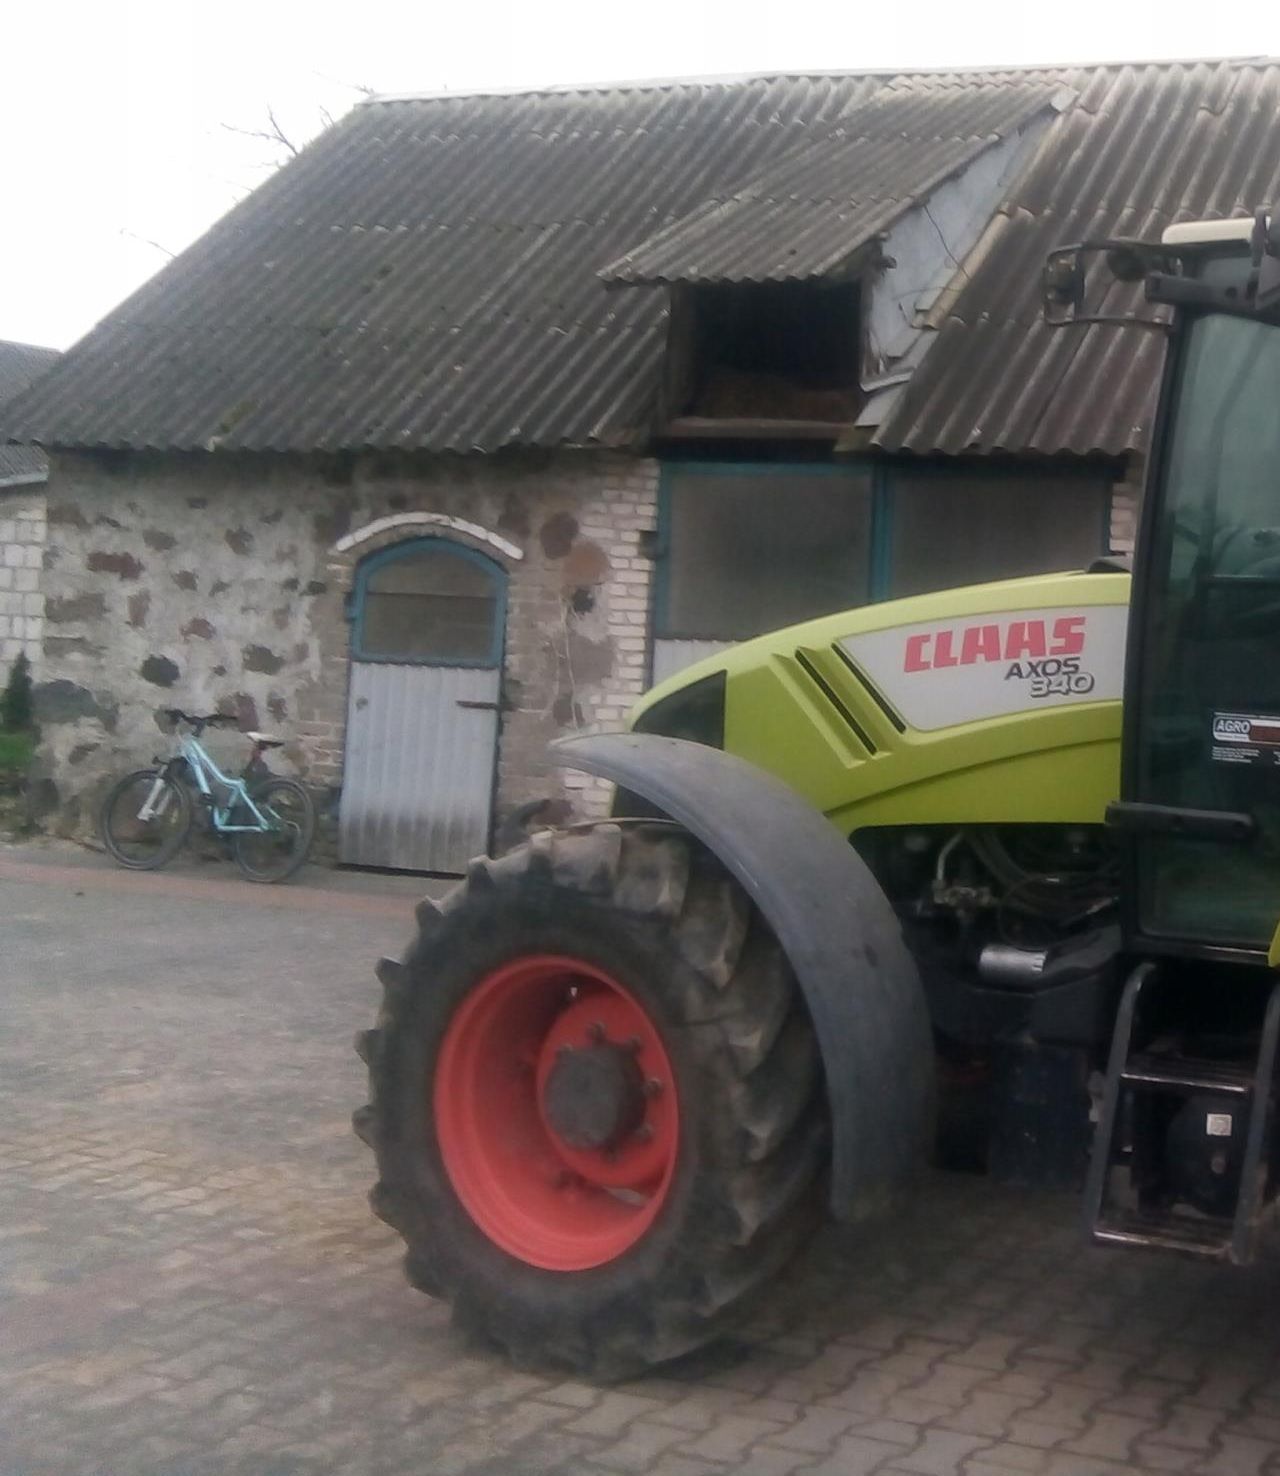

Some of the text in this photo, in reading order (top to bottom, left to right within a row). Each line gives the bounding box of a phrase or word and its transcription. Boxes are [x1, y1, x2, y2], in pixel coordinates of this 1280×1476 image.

[904, 617, 1087, 673] CLAAS
[1004, 657, 1081, 681] AXOS
[1030, 671, 1095, 699] 340
[1216, 719, 1251, 734] AGRO
